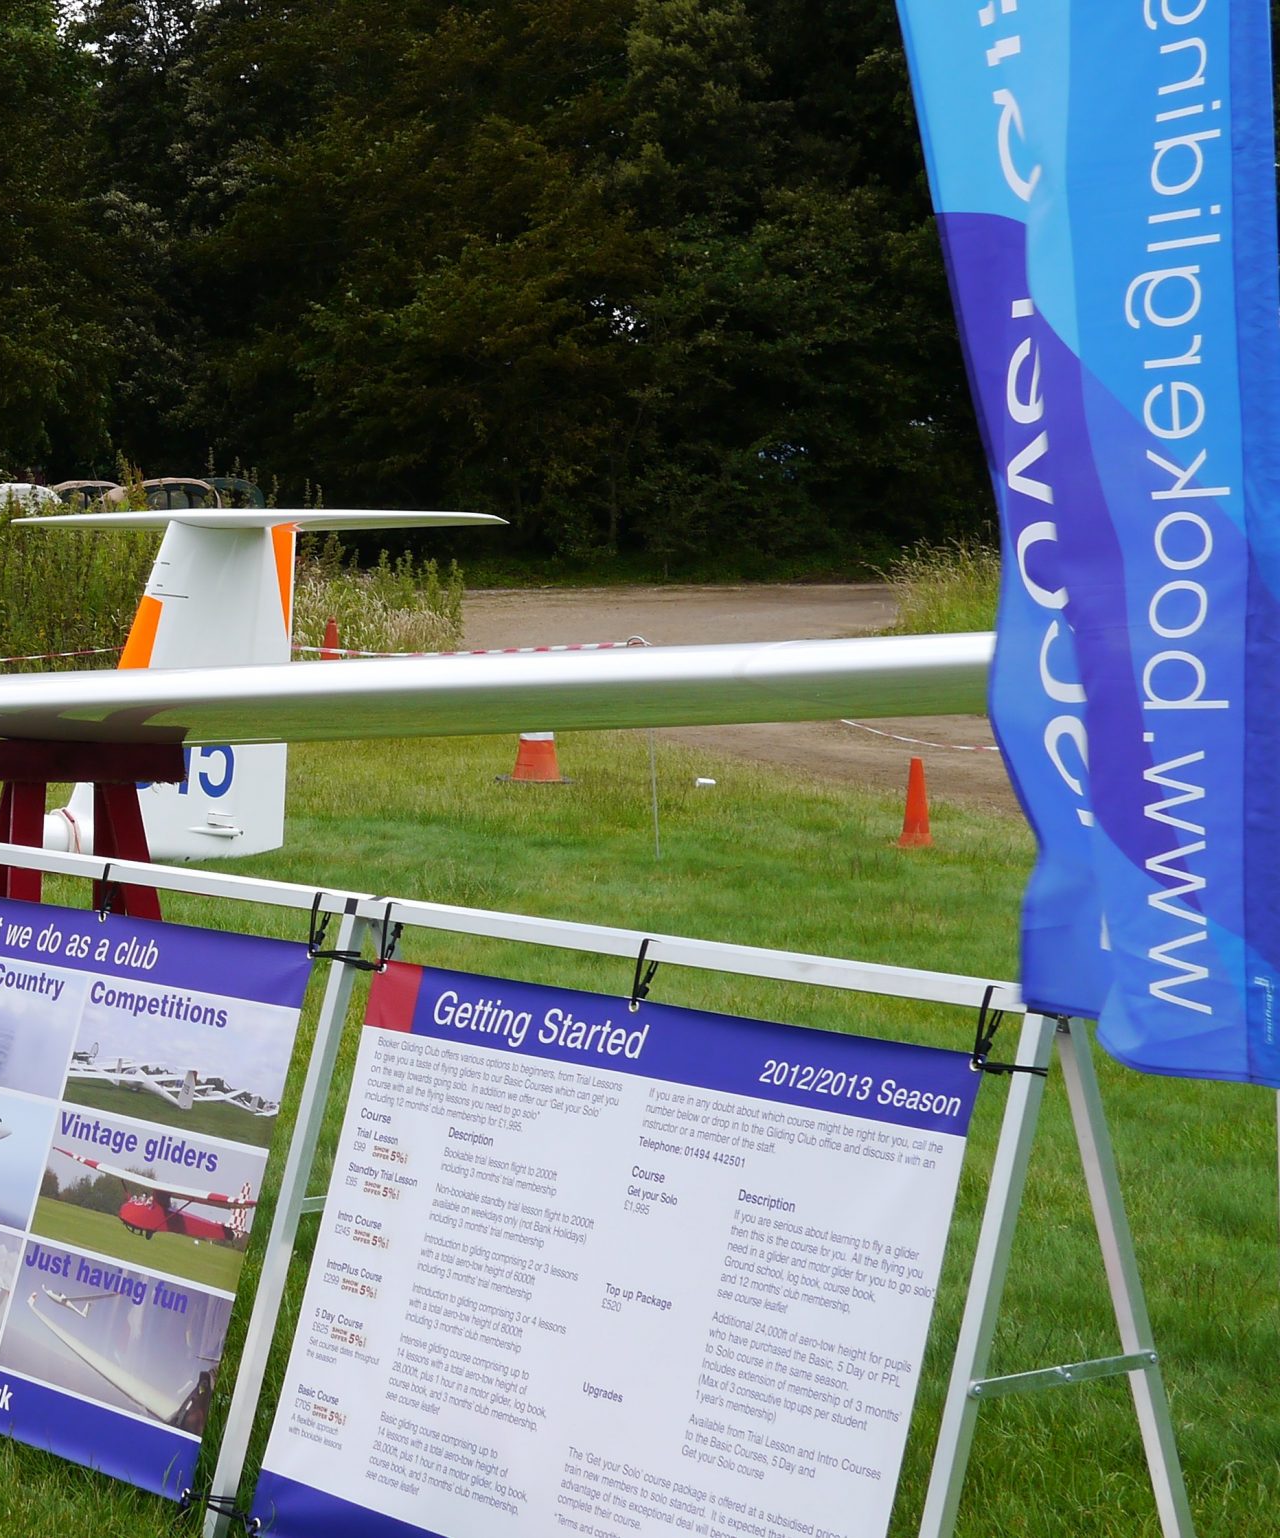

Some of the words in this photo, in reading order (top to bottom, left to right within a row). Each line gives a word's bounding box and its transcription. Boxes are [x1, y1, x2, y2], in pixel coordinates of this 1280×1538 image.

[4, 923, 33, 948] we
[36, 923, 62, 954] do
[64, 933, 92, 958] as
[93, 938, 110, 962] a
[113, 936, 159, 970] club
[90, 980, 228, 1028] Competitions
[433, 990, 533, 1047] Getting
[537, 1007, 650, 1059] Started
[758, 1059, 873, 1101] 2012/2013
[876, 1078, 961, 1117] Season
[359, 1106, 392, 1125] Course
[61, 1111, 138, 1154] Vintage
[143, 1135, 218, 1172] gliders
[356, 1125, 373, 1140] Trial
[372, 1130, 399, 1146] Lesson
[447, 1125, 494, 1147] Description
[638, 1134, 683, 1155] Telephone:
[683, 1144, 711, 1161] 01494
[711, 1151, 746, 1169] 442501
[347, 1160, 380, 1180] Standby
[379, 1168, 395, 1182] Trial
[393, 1172, 419, 1188] Lesson
[630, 1164, 666, 1184] Course
[626, 1183, 642, 1198] Get
[640, 1189, 660, 1202] your
[659, 1190, 679, 1206] Solo
[737, 1187, 796, 1213] Description
[336, 1209, 354, 1223] Intro
[353, 1213, 383, 1231] Course
[25, 1244, 71, 1278] Just
[75, 1258, 148, 1306] having
[152, 1280, 187, 1313] fun
[325, 1257, 360, 1277] IntroPlus
[359, 1266, 383, 1284] Course
[605, 1281, 622, 1298] Top
[621, 1288, 635, 1302] up
[634, 1289, 673, 1312] Package
[314, 1306, 321, 1318] 5
[320, 1307, 337, 1325] Day
[336, 1312, 364, 1331] Course
[296, 1382, 317, 1399] Basic
[315, 1388, 340, 1407] Course
[581, 1380, 624, 1404] Upgrades
